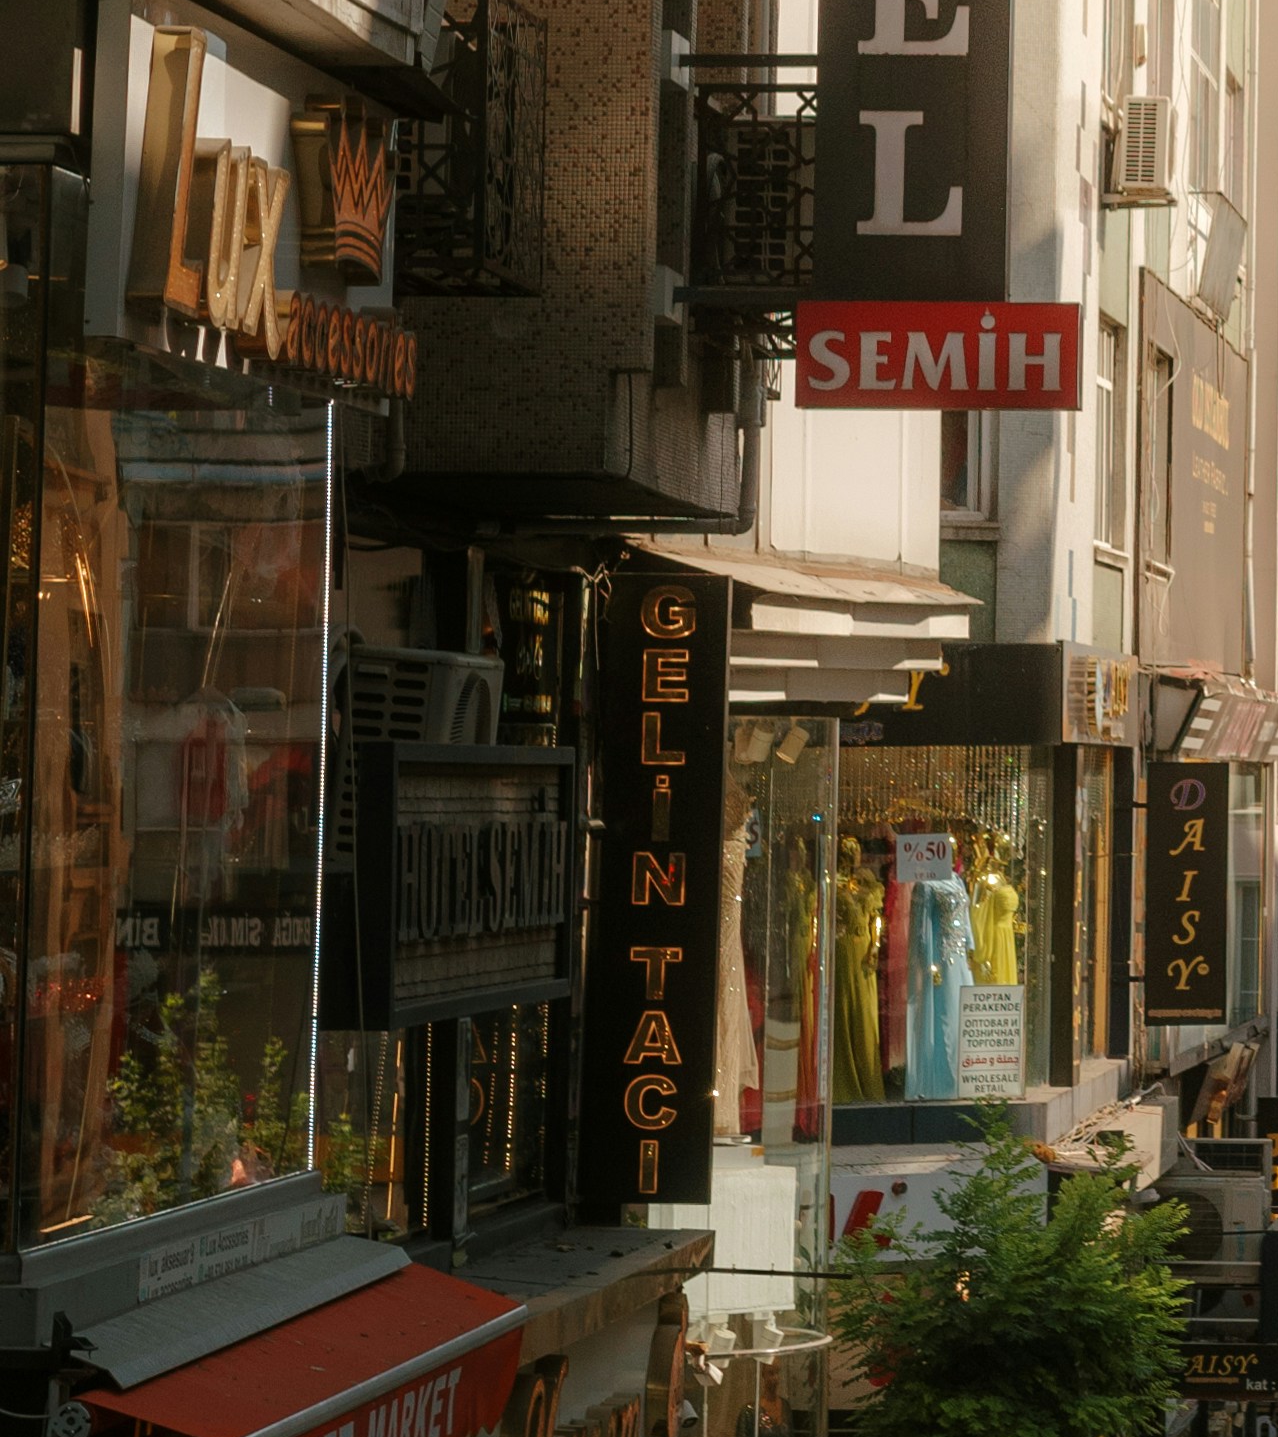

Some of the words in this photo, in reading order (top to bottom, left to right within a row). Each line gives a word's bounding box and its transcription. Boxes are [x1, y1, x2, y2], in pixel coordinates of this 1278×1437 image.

[904, 840, 947, 862] %50
[399, 821, 484, 940] HOTEL
[1167, 778, 1211, 991] DAISY
[973, 993, 1011, 1002] TOPTAN
[963, 1003, 1020, 1012] PERAKENDE
[962, 1029, 1020, 1038] РОЗНИЧНАЯ
[624, 946, 682, 1195] TACI
[961, 1074, 1019, 1083] WHOLESALE
[974, 1085, 1006, 1093] RETAIL
[1176, 1352, 1260, 1376] AISY
[1246, 1378, 1268, 1391] kat
